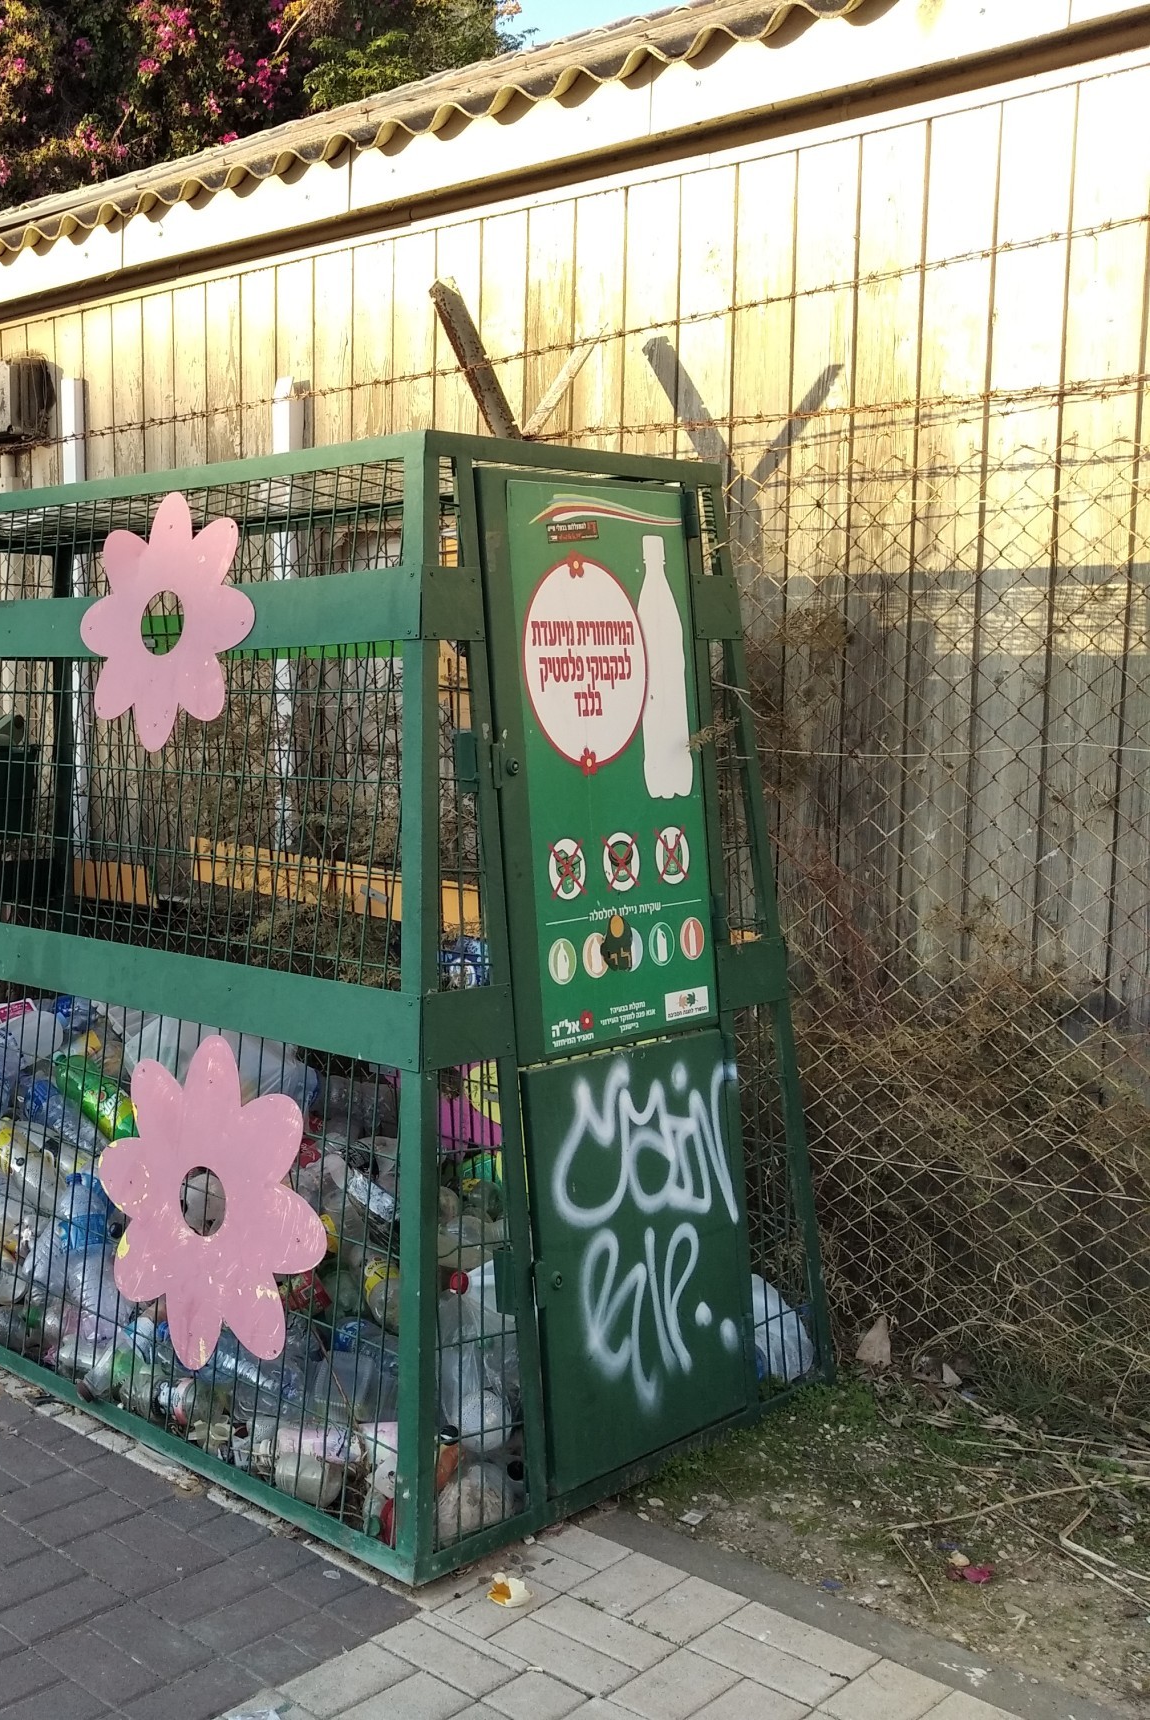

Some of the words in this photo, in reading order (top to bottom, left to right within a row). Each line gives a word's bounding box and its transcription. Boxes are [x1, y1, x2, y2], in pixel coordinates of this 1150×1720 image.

[531, 620, 575, 647] מיועדת
[576, 620, 635, 646] המיחזורית
[538, 648, 584, 693] פלסטיק
[586, 647, 632, 691] לבקבוקי
[574, 683, 603, 717] בלבד
[639, 902, 662, 915] שקיות
